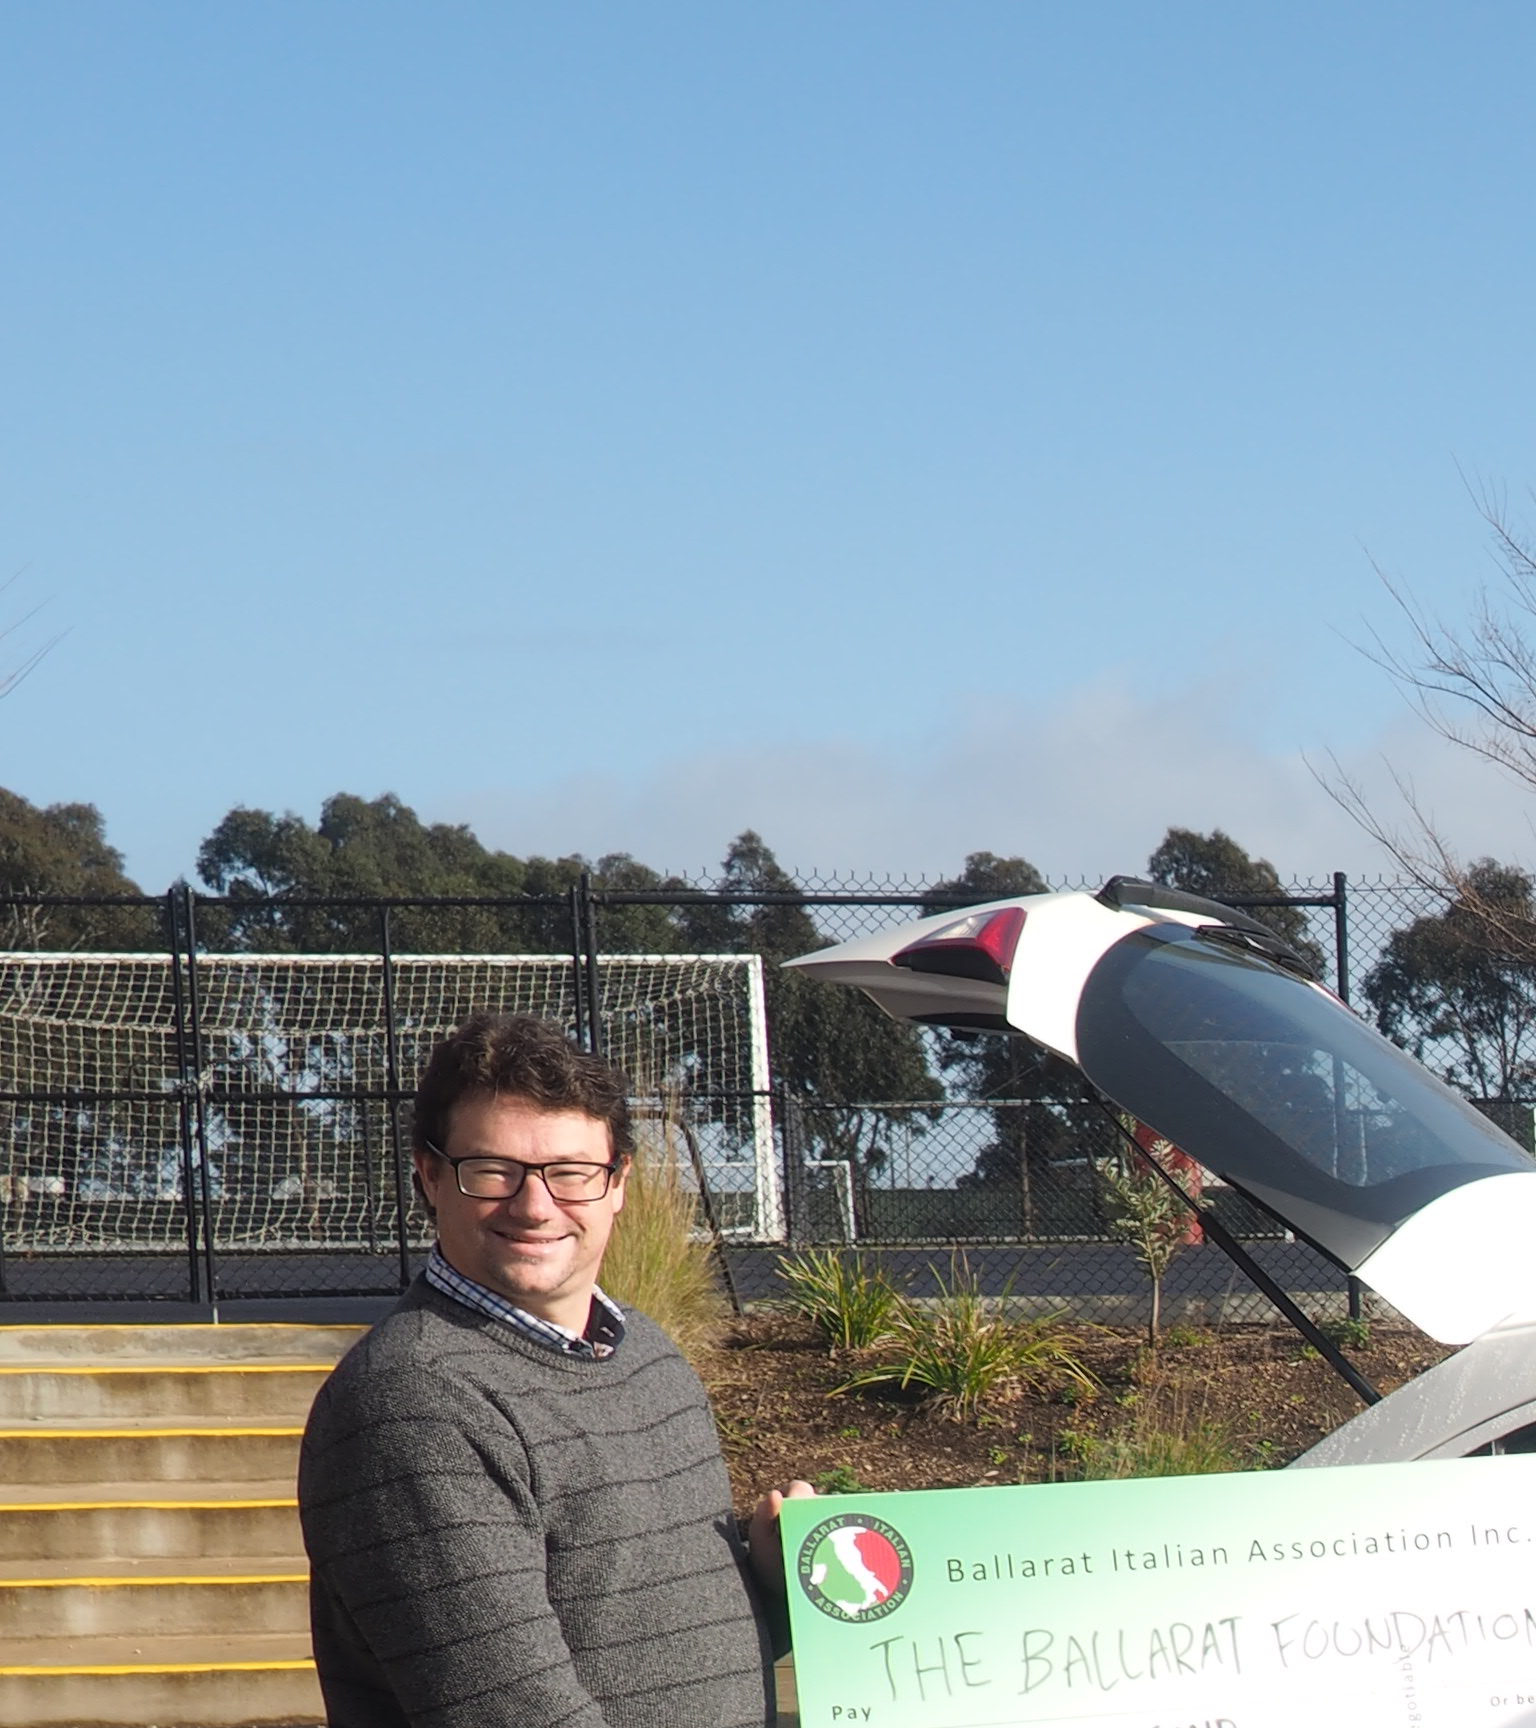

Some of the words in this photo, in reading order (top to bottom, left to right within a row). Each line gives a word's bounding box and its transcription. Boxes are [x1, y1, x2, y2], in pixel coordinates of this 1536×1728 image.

[801, 1517, 846, 1575] BALLARAT
[873, 1520, 911, 1569] ITALIAN
[946, 1552, 1093, 1583] Ballarat
[1111, 1544, 1229, 1572] Italian
[1248, 1529, 1453, 1562] Association
[1470, 1524, 1532, 1547] Inc.
[815, 1590, 904, 1621] ASSOCIATION
[870, 1629, 992, 1702] THE
[1018, 1616, 1244, 1694] BALLARAT
[832, 1705, 872, 1722] Pay
[1489, 1696, 1508, 1707] Or
